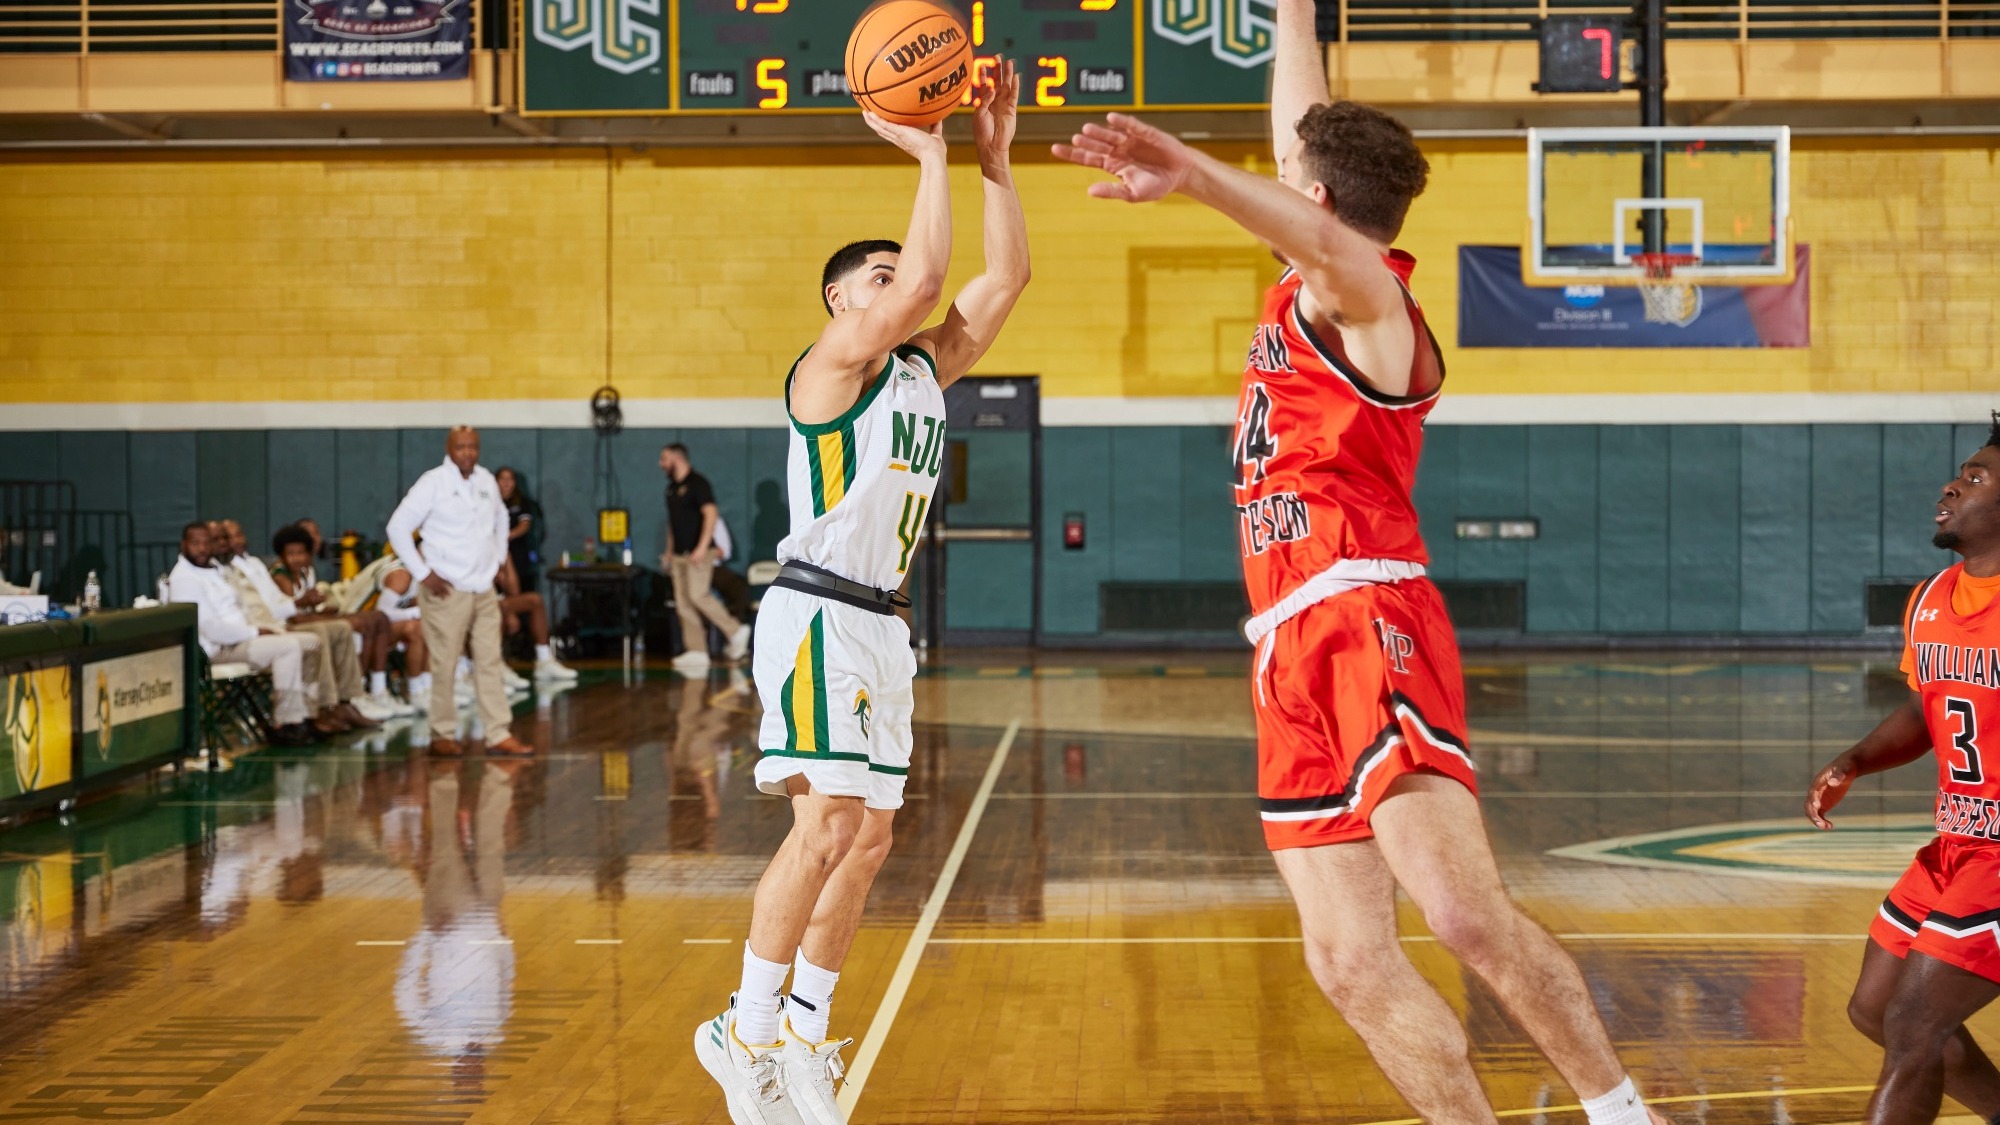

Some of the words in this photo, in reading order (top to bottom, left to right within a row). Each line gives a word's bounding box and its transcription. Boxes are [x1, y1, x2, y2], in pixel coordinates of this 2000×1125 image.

[884, 26, 962, 73] Wilson
[1582, 28, 1612, 80] 7
[689, 72, 734, 96] fouls
[756, 58, 788, 109] 5
[812, 69, 851, 97] play
[918, 60, 968, 104] NCAA
[1036, 56, 1068, 107] 2
[1080, 67, 1125, 93] fouls
[1553, 307, 1600, 322] Division
[1945, 695, 1984, 785] 3
[1936, 787, 2000, 842] ATERSO
